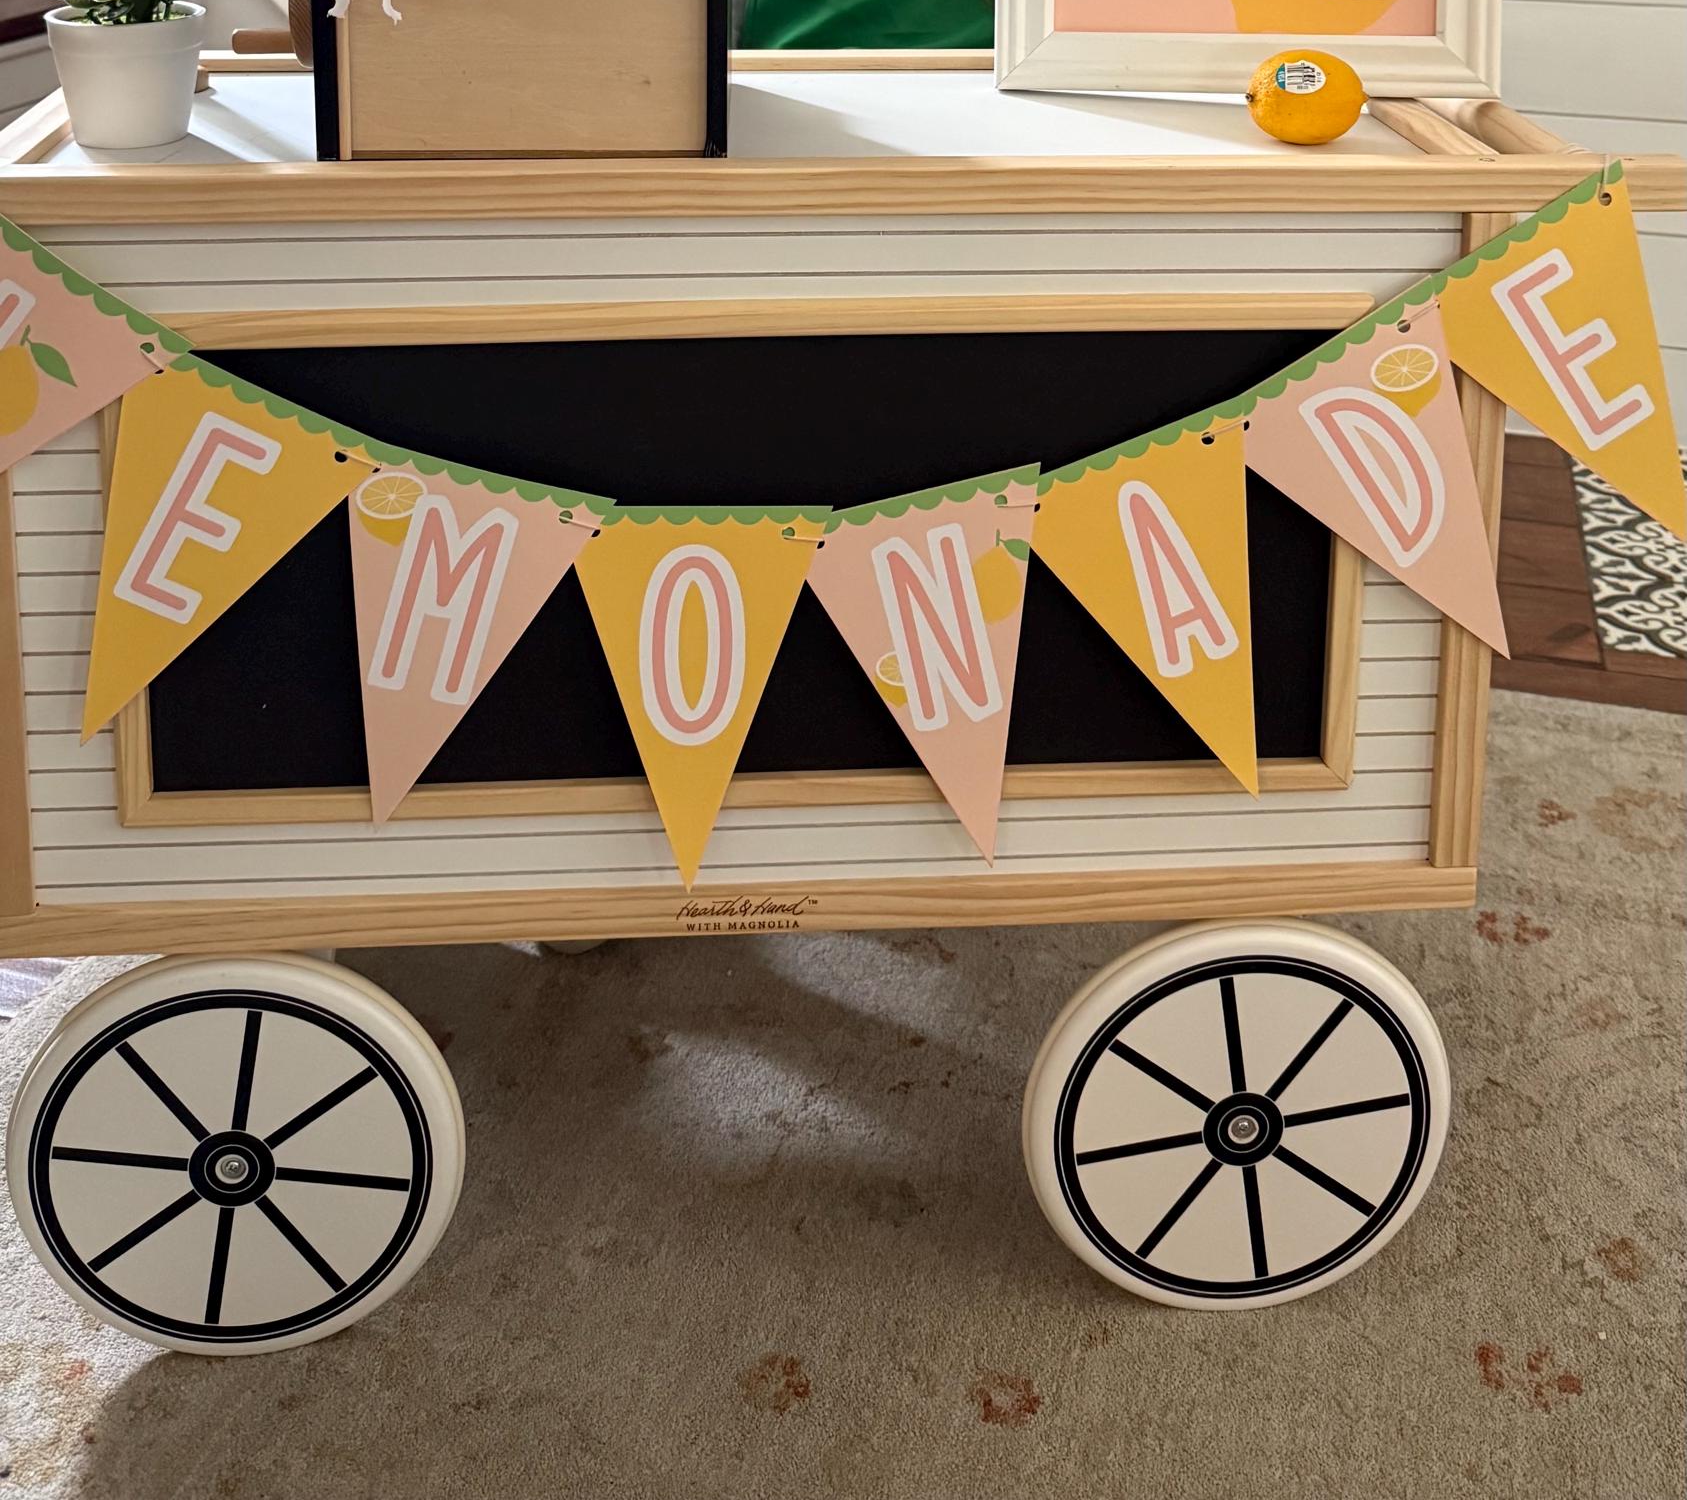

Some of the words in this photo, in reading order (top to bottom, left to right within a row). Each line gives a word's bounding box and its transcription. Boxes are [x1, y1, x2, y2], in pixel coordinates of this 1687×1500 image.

[0, 248, 1656, 748] EMONADE
[676, 895, 742, 920] Hearth
[739, 899, 752, 918] &
[686, 921, 721, 932] WITH
[728, 919, 800, 931] MAGNOLIA
